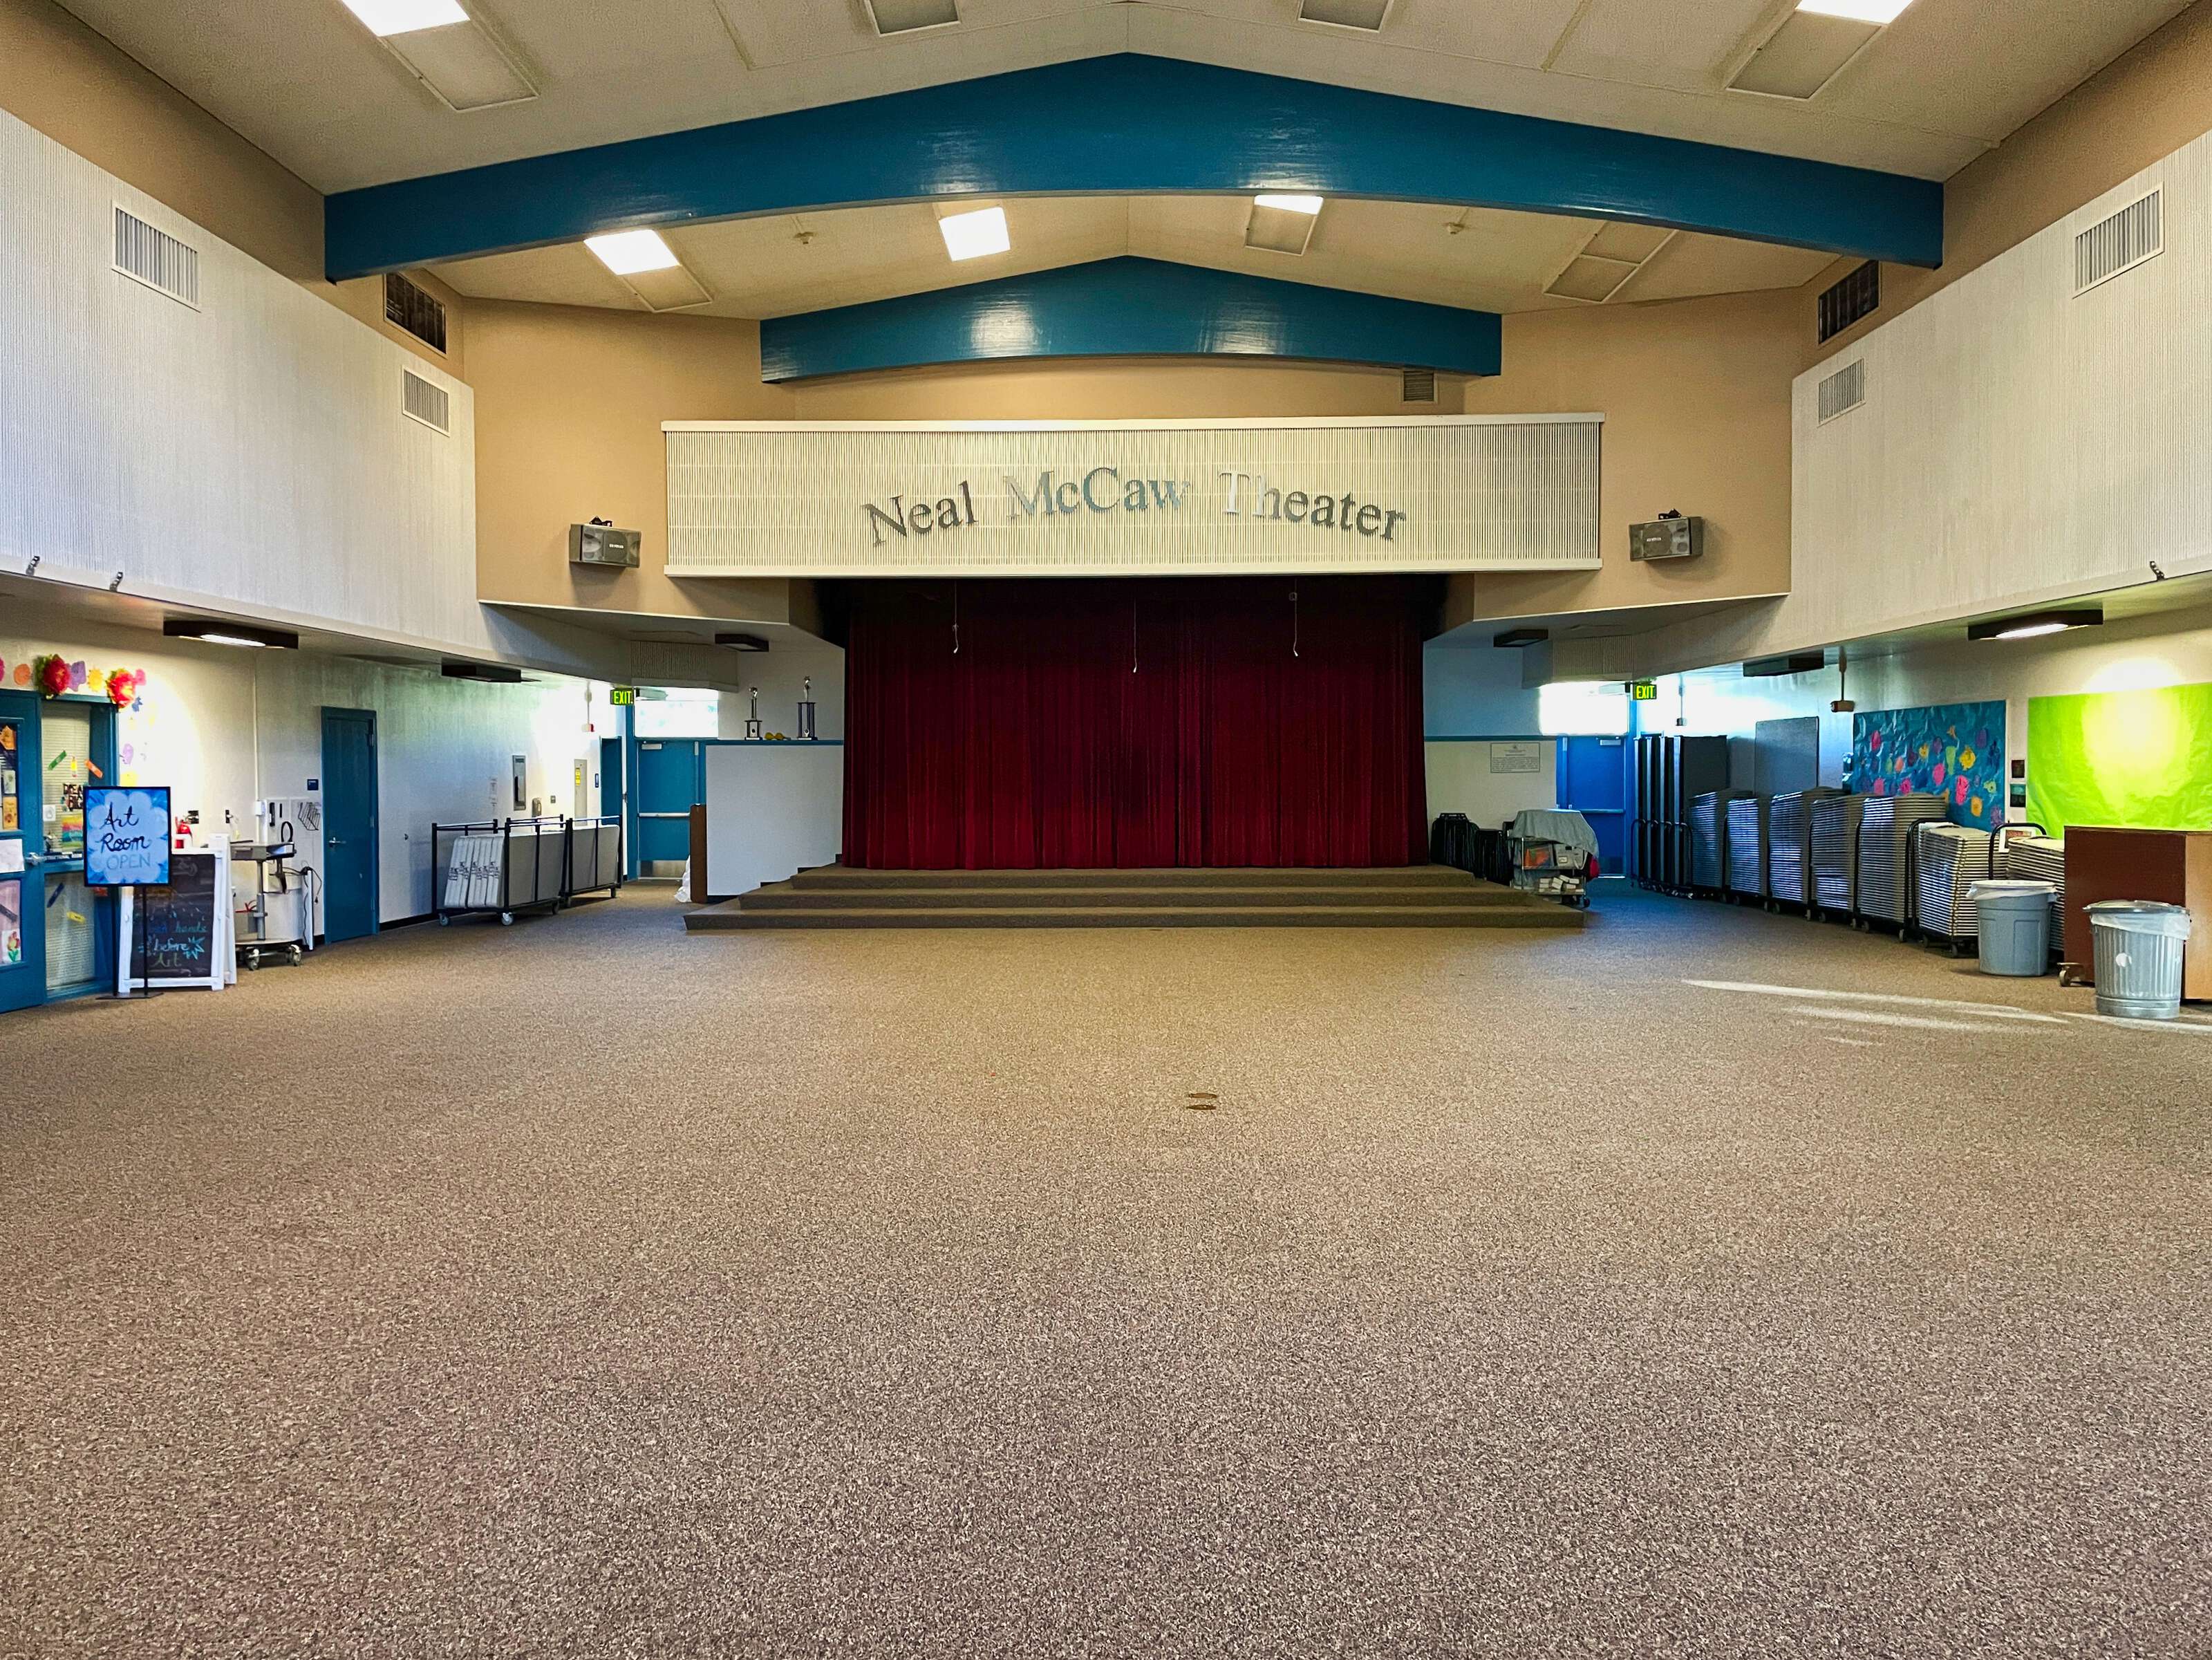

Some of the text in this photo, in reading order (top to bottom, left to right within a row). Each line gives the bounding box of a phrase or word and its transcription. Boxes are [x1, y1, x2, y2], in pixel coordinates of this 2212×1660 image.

[861, 467, 1407, 548] Neal McCaw Theater
[613, 691, 632, 704] EXIT
[1636, 685, 1655, 699] EXIT
[99, 801, 139, 832] Art
[95, 832, 152, 854] Room
[106, 852, 151, 870] OPEN
[153, 938, 189, 952] before
